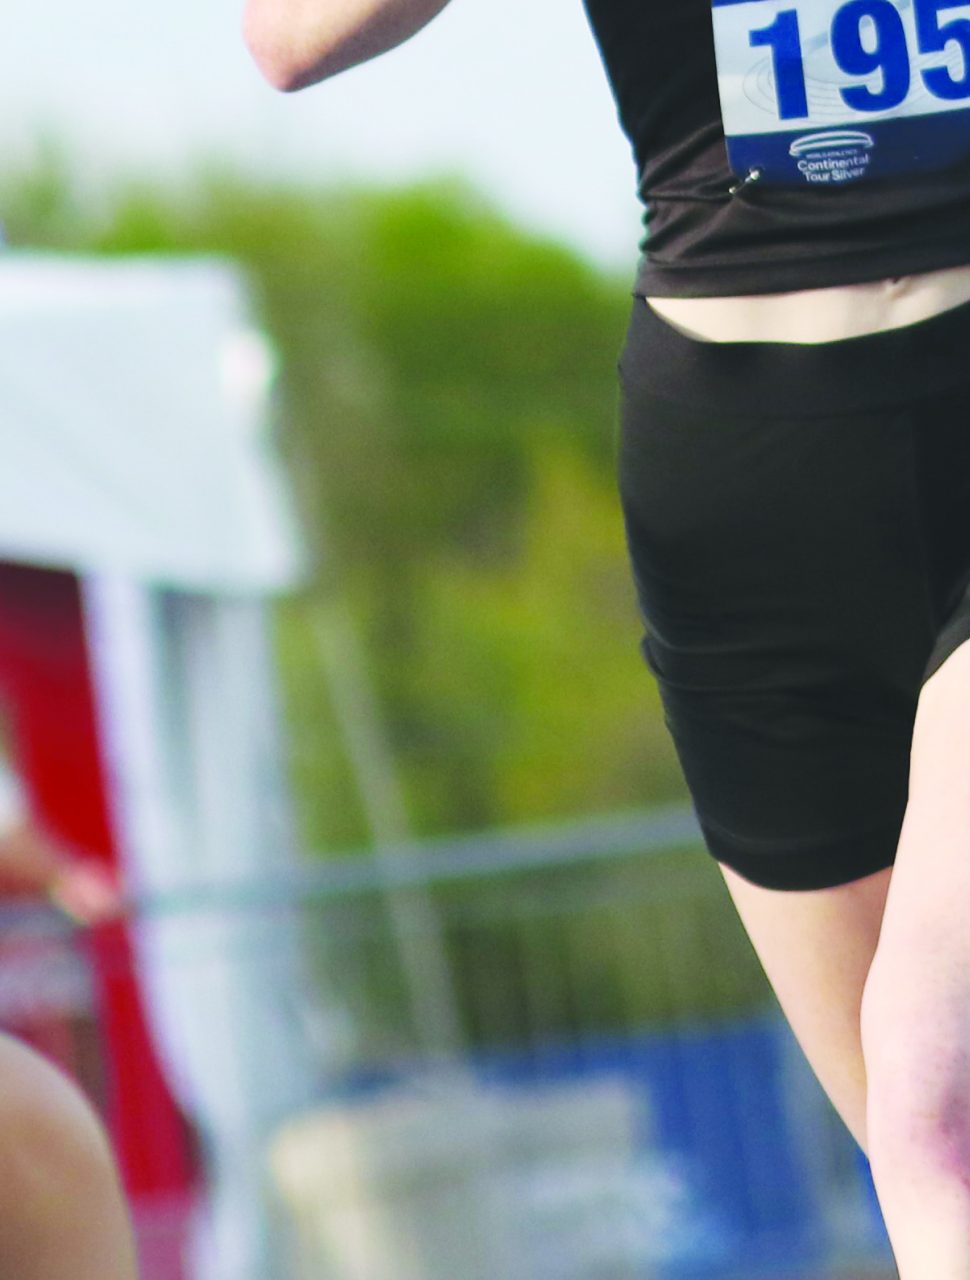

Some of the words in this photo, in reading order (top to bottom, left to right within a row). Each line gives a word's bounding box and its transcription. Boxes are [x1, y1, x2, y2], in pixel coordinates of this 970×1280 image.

[797, 152, 869, 172] Continental
[803, 170, 830, 182] Tour
[831, 166, 865, 182] Silver
